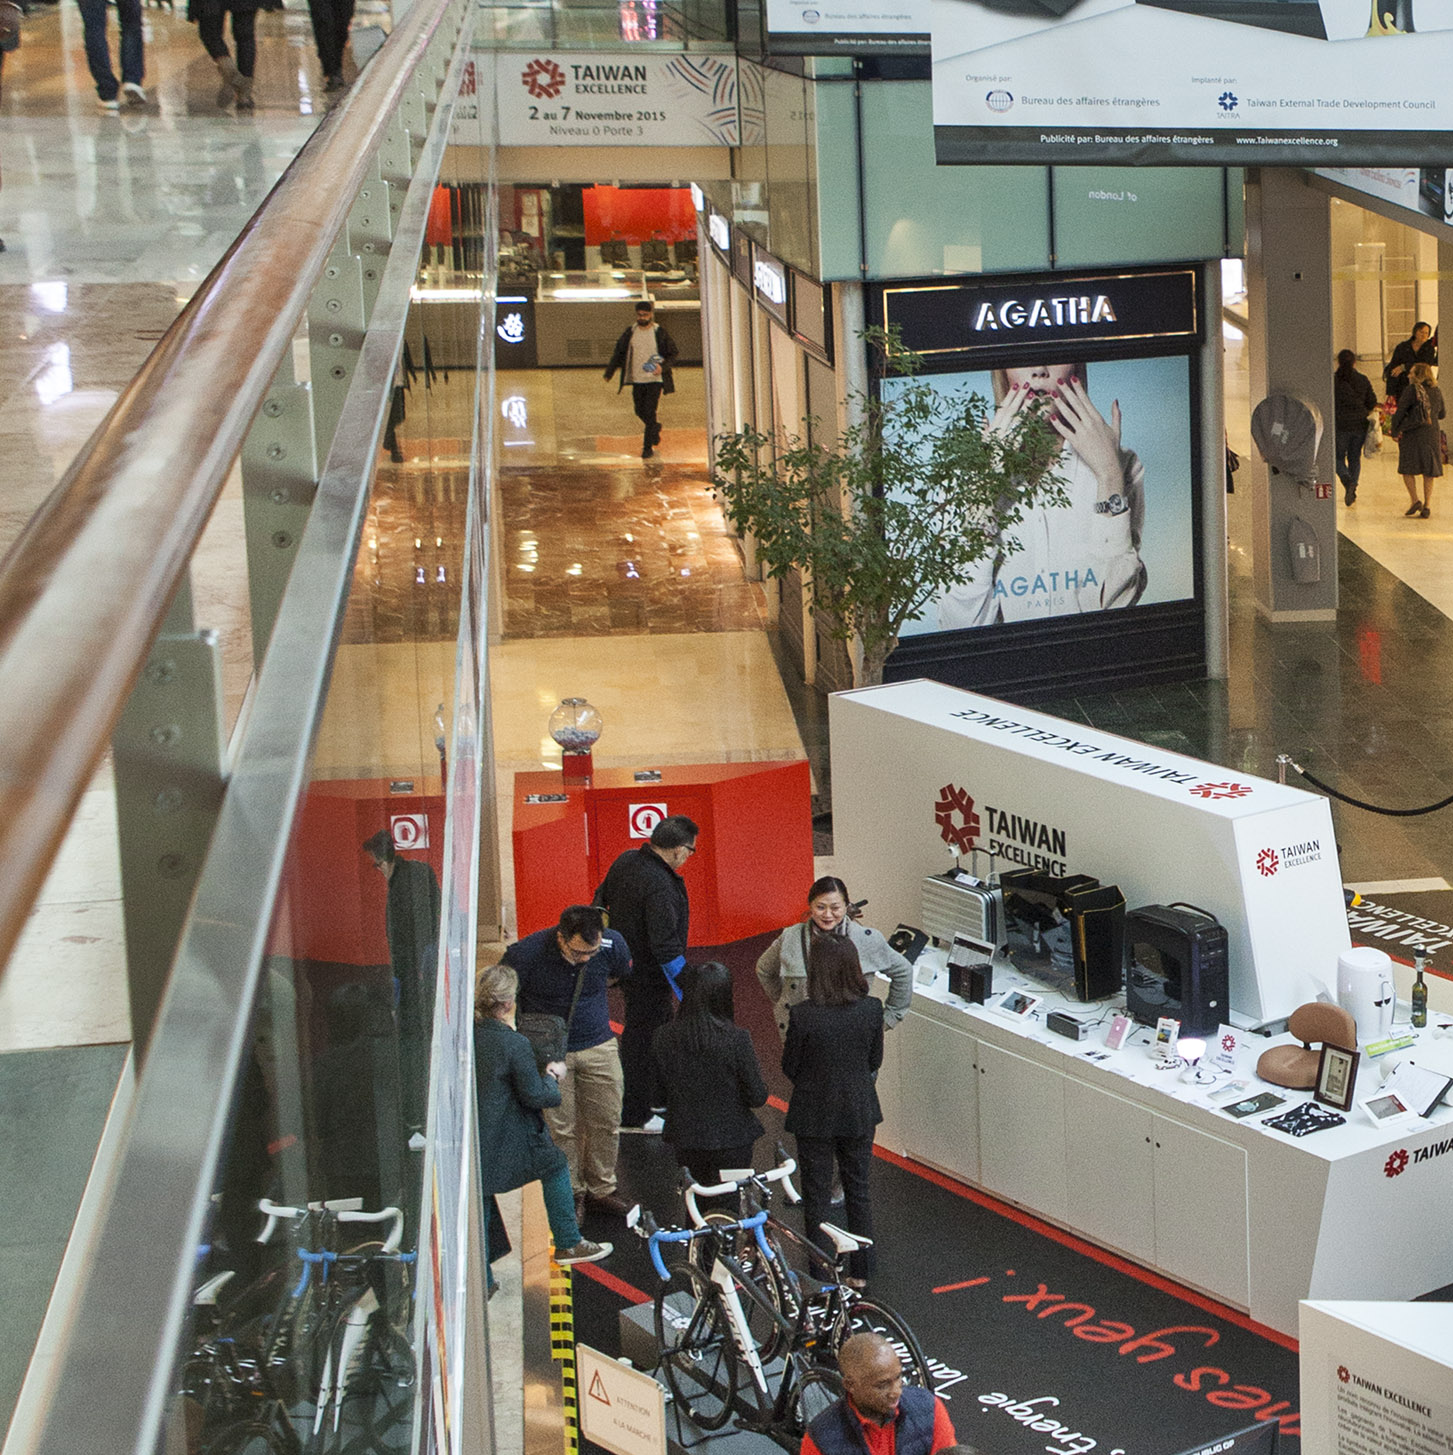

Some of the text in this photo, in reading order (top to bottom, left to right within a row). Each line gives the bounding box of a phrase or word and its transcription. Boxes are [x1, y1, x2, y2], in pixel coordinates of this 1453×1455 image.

[571, 65, 647, 81] TAIWAN
[575, 84, 647, 94] EXCELLENCE
[1021, 96, 1160, 108] Bureau des affaires étrangères
[1247, 98, 1436, 110] Taiwan External Trade Development Council
[529, 106, 666, 121] 2 au 7 Novembre 2015
[549, 125, 589, 136] Niveau
[603, 125, 634, 136] Porte
[637, 125, 644, 136] 3
[1040, 134, 1076, 143] Publicité
[1077, 135, 1093, 145] par:
[1095, 134, 1124, 144] Bureau
[1125, 134, 1141, 144] des
[1141, 134, 1171, 144] affaires
[1172, 135, 1214, 146] étrangères
[975, 295, 1118, 331] AGATHA
[992, 567, 1098, 599] AGATHA
[1027, 597, 1066, 609] PARIS
[949, 709, 1199, 785] TAIWAN EXCELLENCE
[985, 805, 1066, 857] TAIWAN
[1281, 839, 1320, 859] TAIWAN
[1284, 852, 1321, 869] EXCELLENCE
[1002, 1283, 1220, 1364] yeux
[1352, 1373, 1432, 1419] TAIWAN EXCELLENCE
